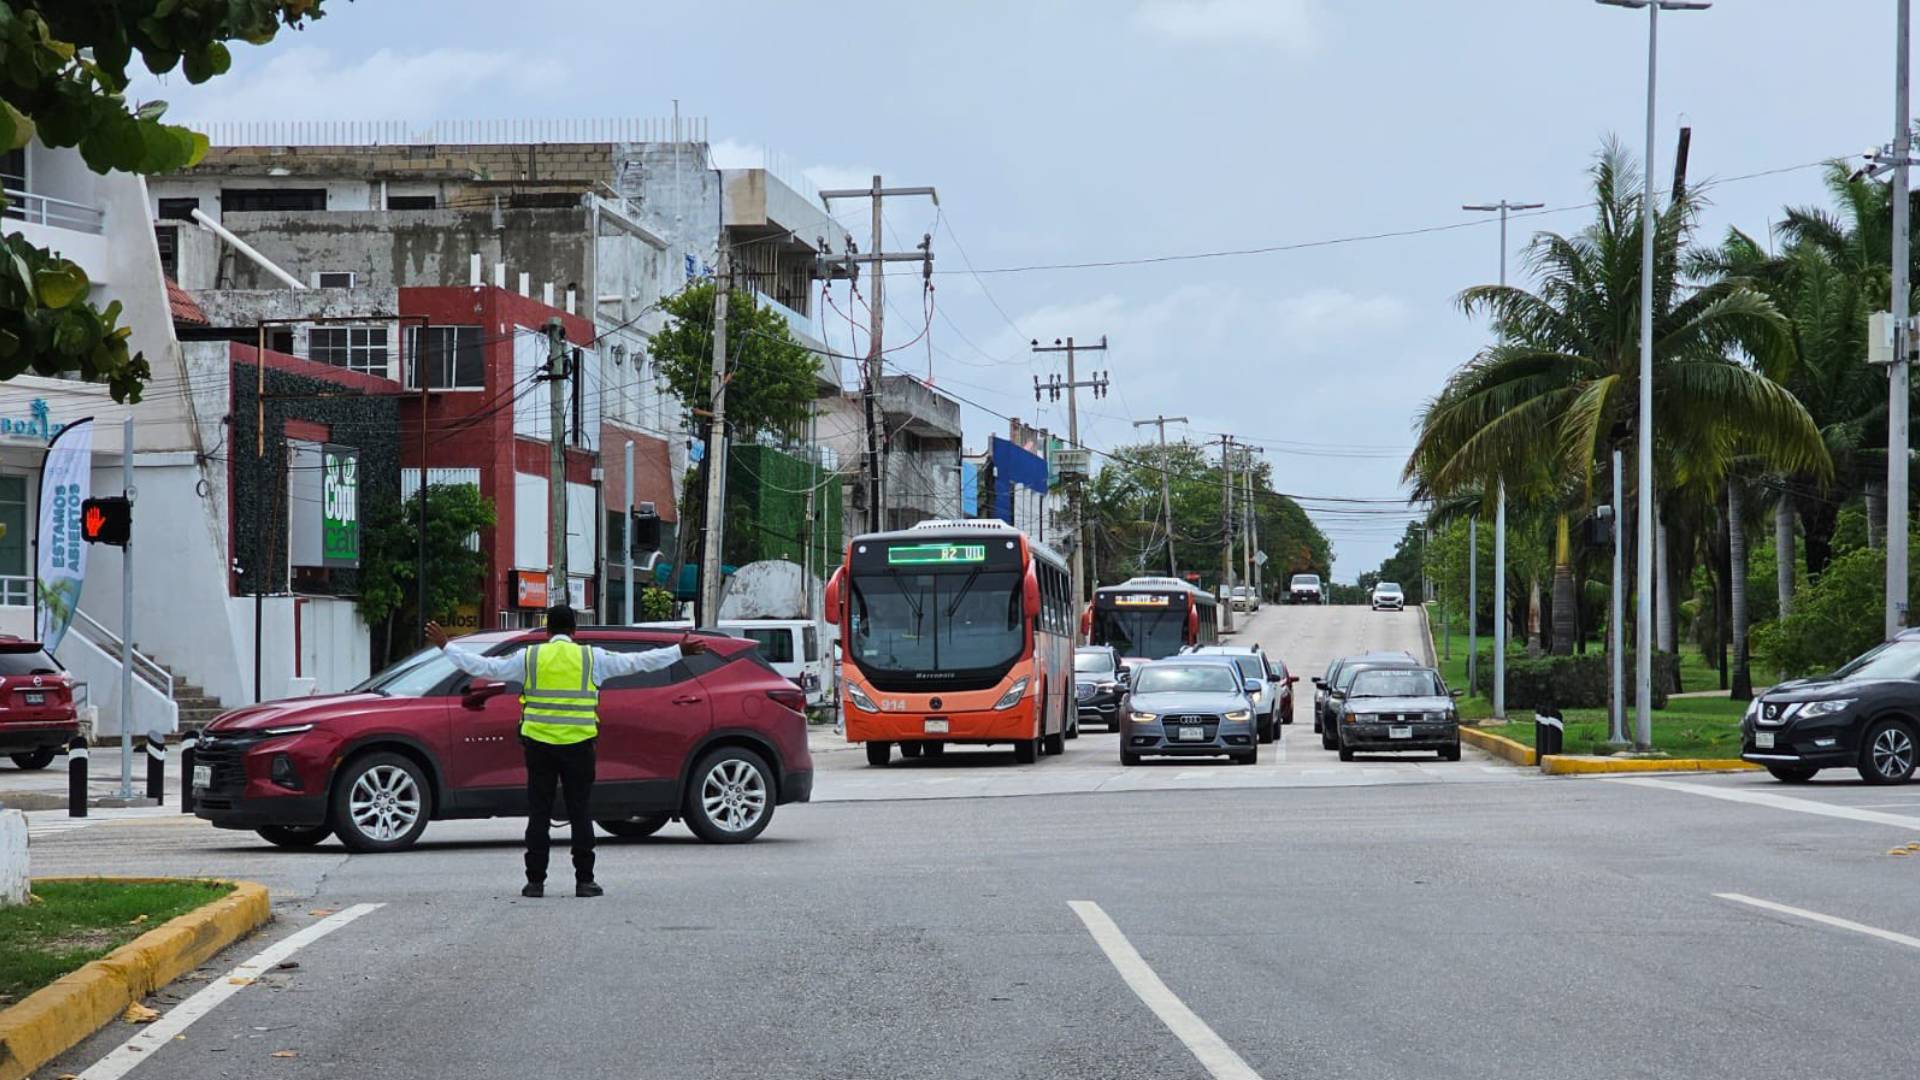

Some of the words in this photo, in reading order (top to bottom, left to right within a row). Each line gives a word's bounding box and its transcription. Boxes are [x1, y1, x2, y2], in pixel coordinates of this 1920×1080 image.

[52, 485, 66, 568] ESTAMOS
[68, 483, 81, 573] ABIERTOS
[324, 475, 356, 527] Copi
[881, 698, 907, 712] 914
